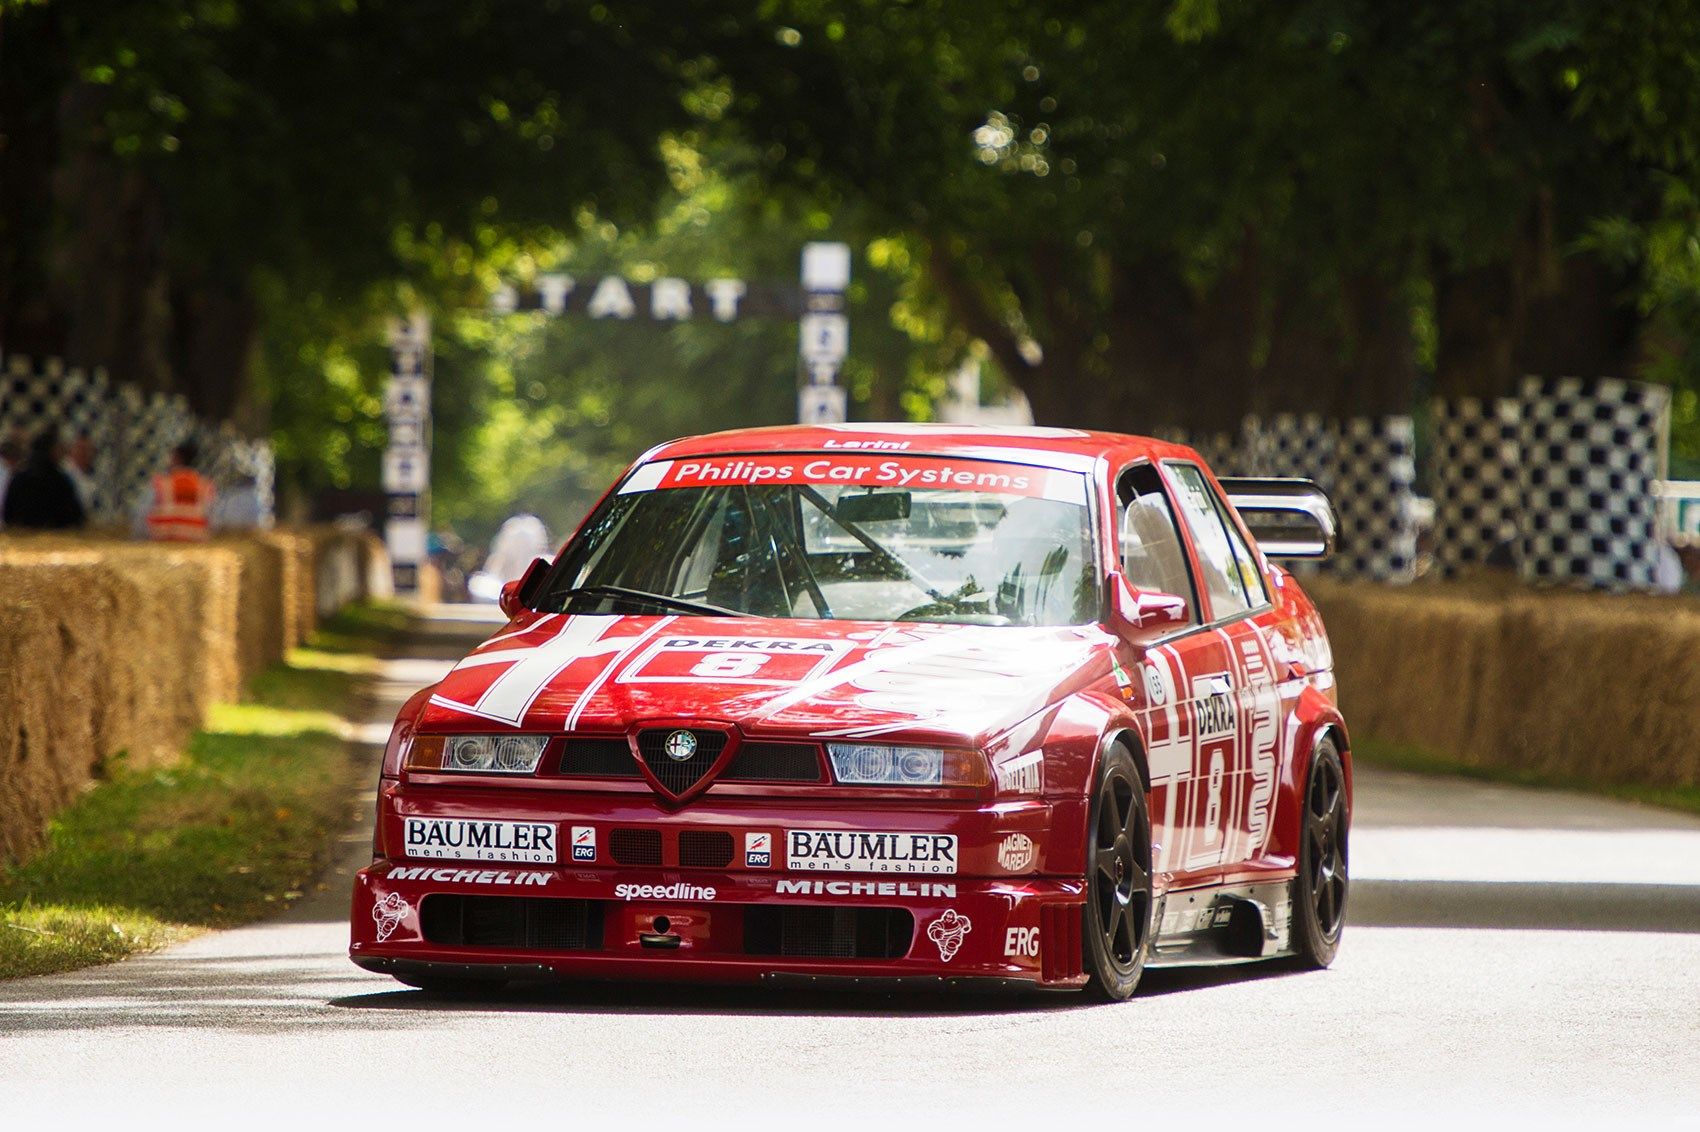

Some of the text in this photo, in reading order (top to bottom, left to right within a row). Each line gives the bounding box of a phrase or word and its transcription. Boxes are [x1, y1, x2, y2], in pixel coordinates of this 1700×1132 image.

[823, 440, 912, 450] Larini
[674, 461, 1029, 489] Philips Car Systems
[664, 639, 834, 651] DEKRA
[689, 652, 772, 677] 8
[1195, 694, 1236, 736] DEKRA
[1204, 748, 1225, 845] 8
[407, 819, 553, 851] BÄUMLER
[408, 848, 554, 862] men's fashion
[574, 847, 594, 858] ERG
[791, 832, 954, 862] BÄUMLER
[748, 853, 769, 864] ERG
[790, 860, 954, 873] men's fashion
[387, 867, 552, 886] MICHELIN
[614, 883, 717, 901] speedline
[776, 880, 957, 898] MICHELIN
[1004, 927, 1040, 957] ERG
